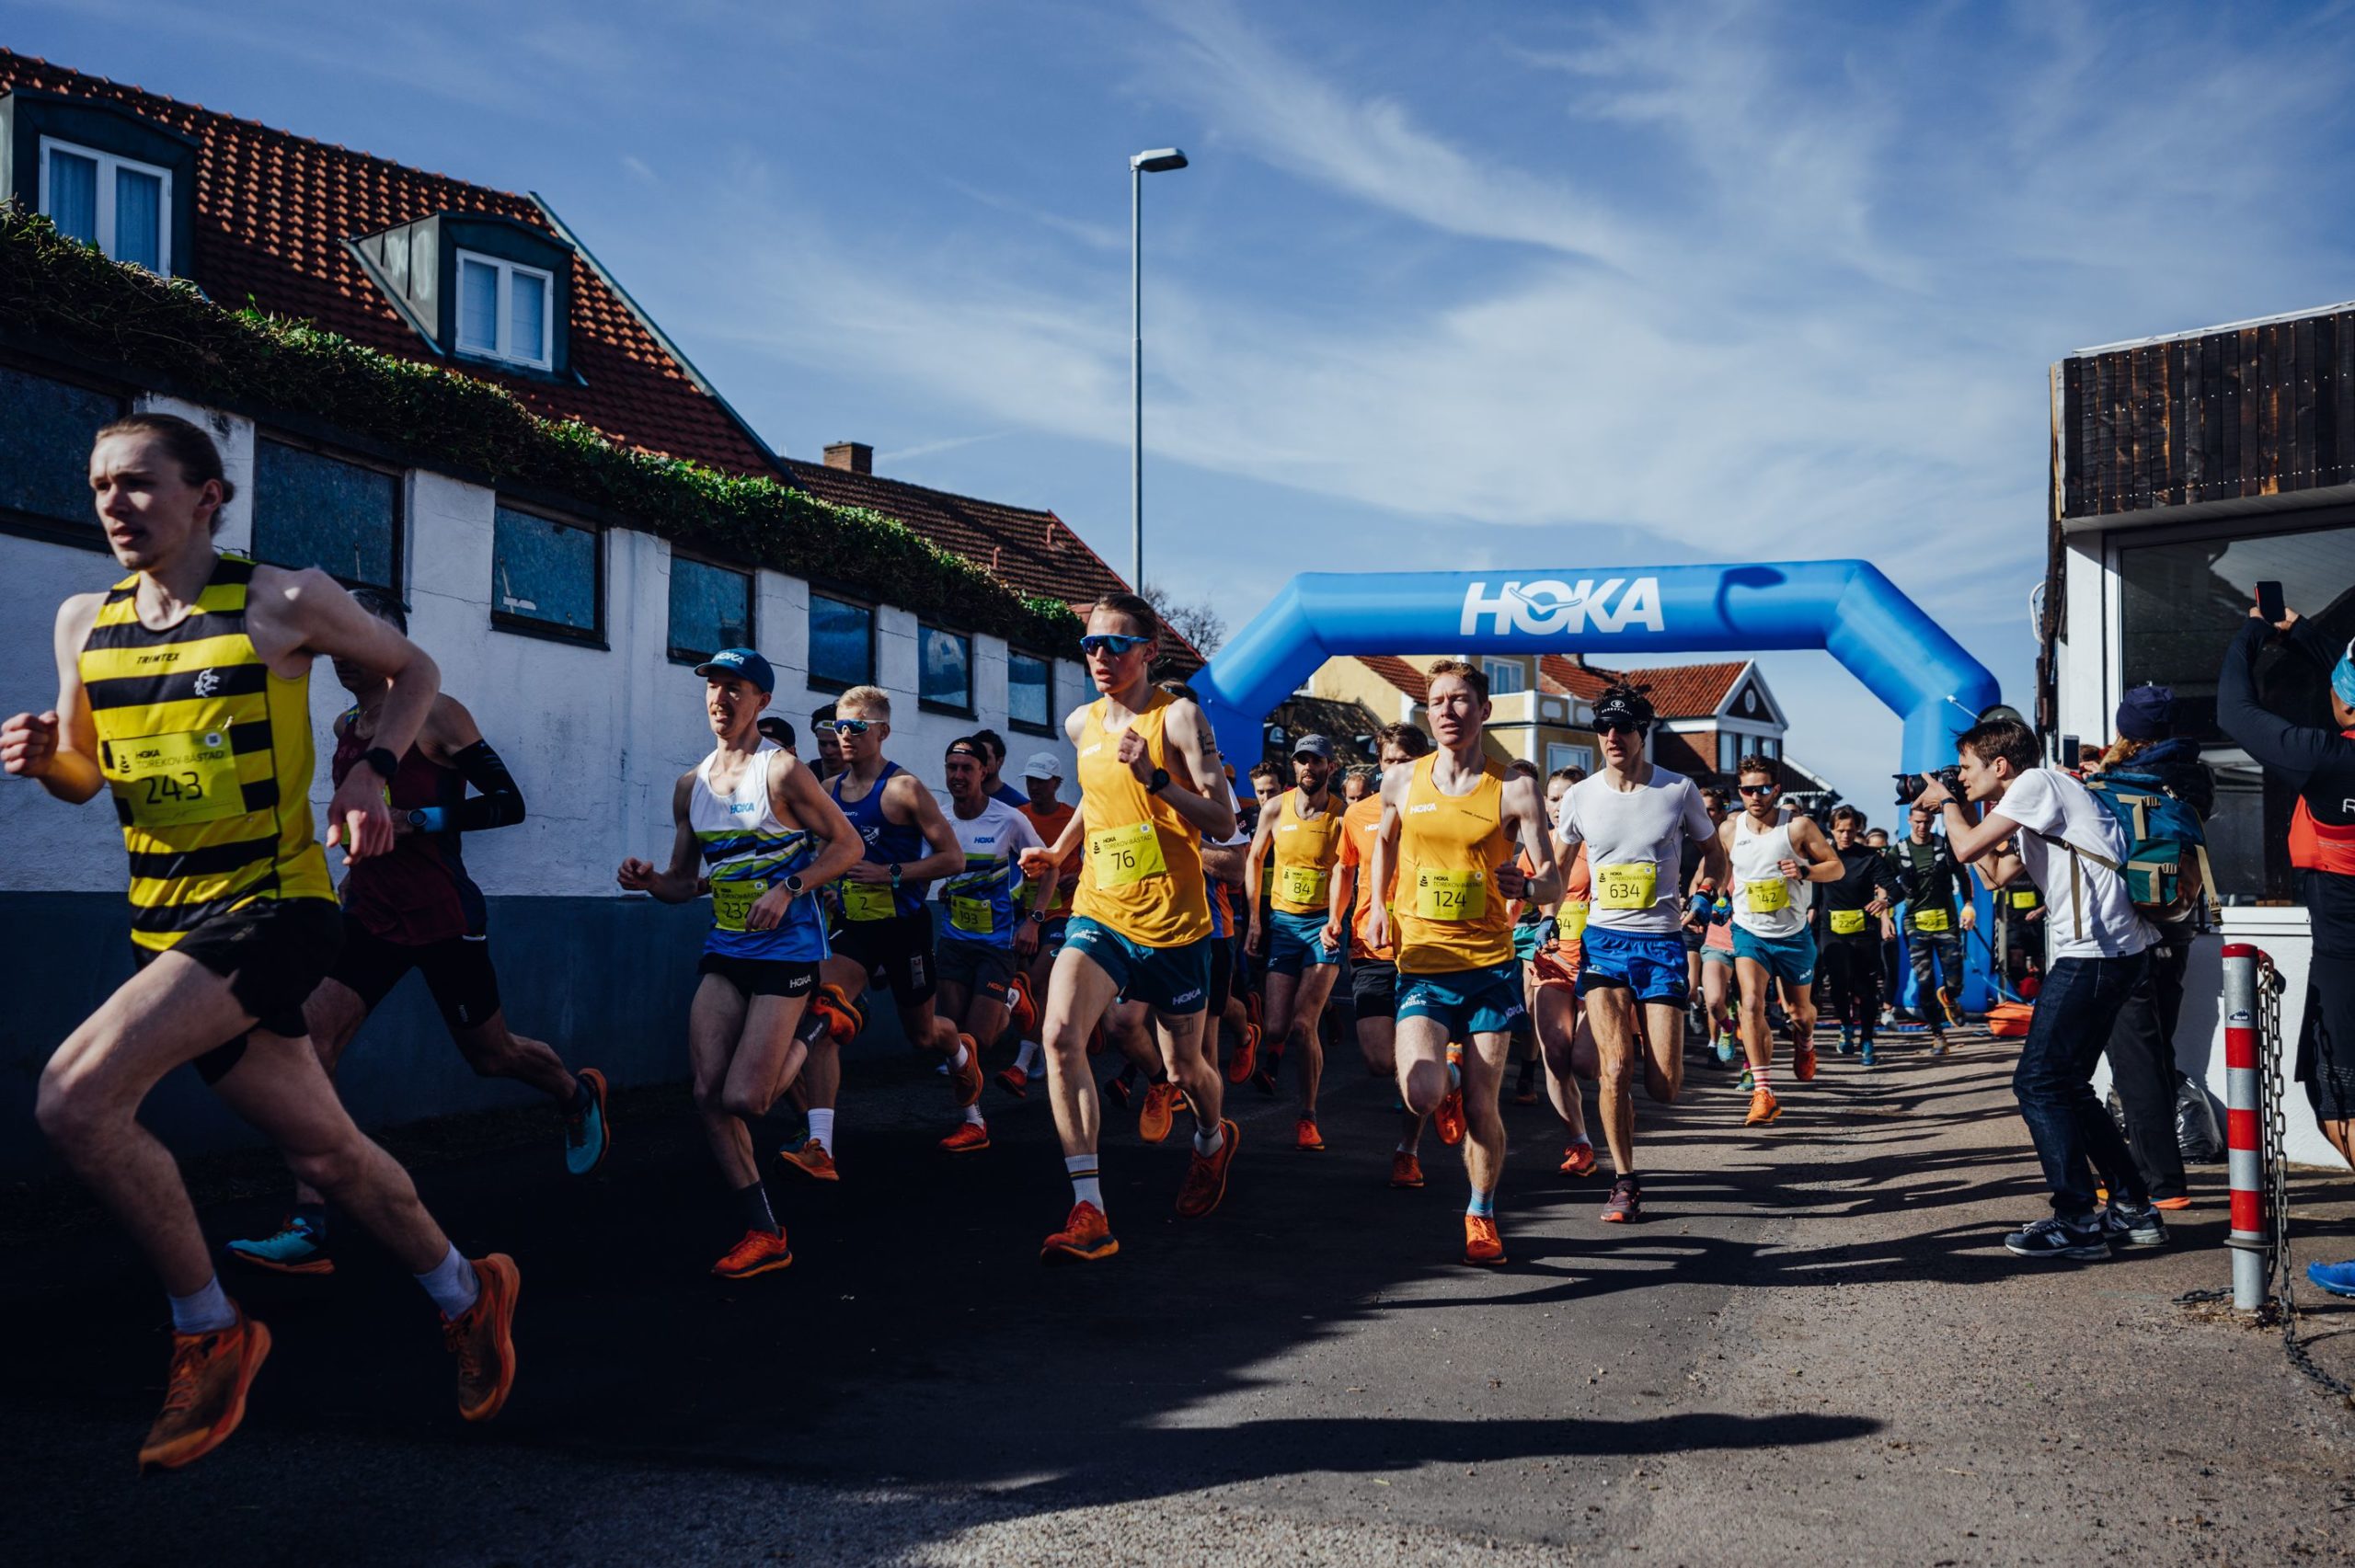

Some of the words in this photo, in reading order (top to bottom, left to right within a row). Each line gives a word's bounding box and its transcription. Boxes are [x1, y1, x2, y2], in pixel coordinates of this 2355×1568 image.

[1460, 577, 1665, 635] HOKA
[137, 652, 180, 665] TRIMTEX
[140, 771, 203, 805] 243
[729, 803, 755, 815] HOKA
[1409, 802, 1437, 815] HOKA
[974, 836, 995, 844] HOKA
[1110, 850, 1136, 871] 76
[1293, 882, 1310, 895] 84
[1610, 883, 1641, 898] 634
[859, 897, 869, 910] 2
[1433, 890, 1467, 908] 124
[959, 910, 978, 925] 193
[789, 975, 811, 989] HOKA
[1172, 988, 1201, 1005] HOKA
[2045, 1230, 2070, 1248] N
